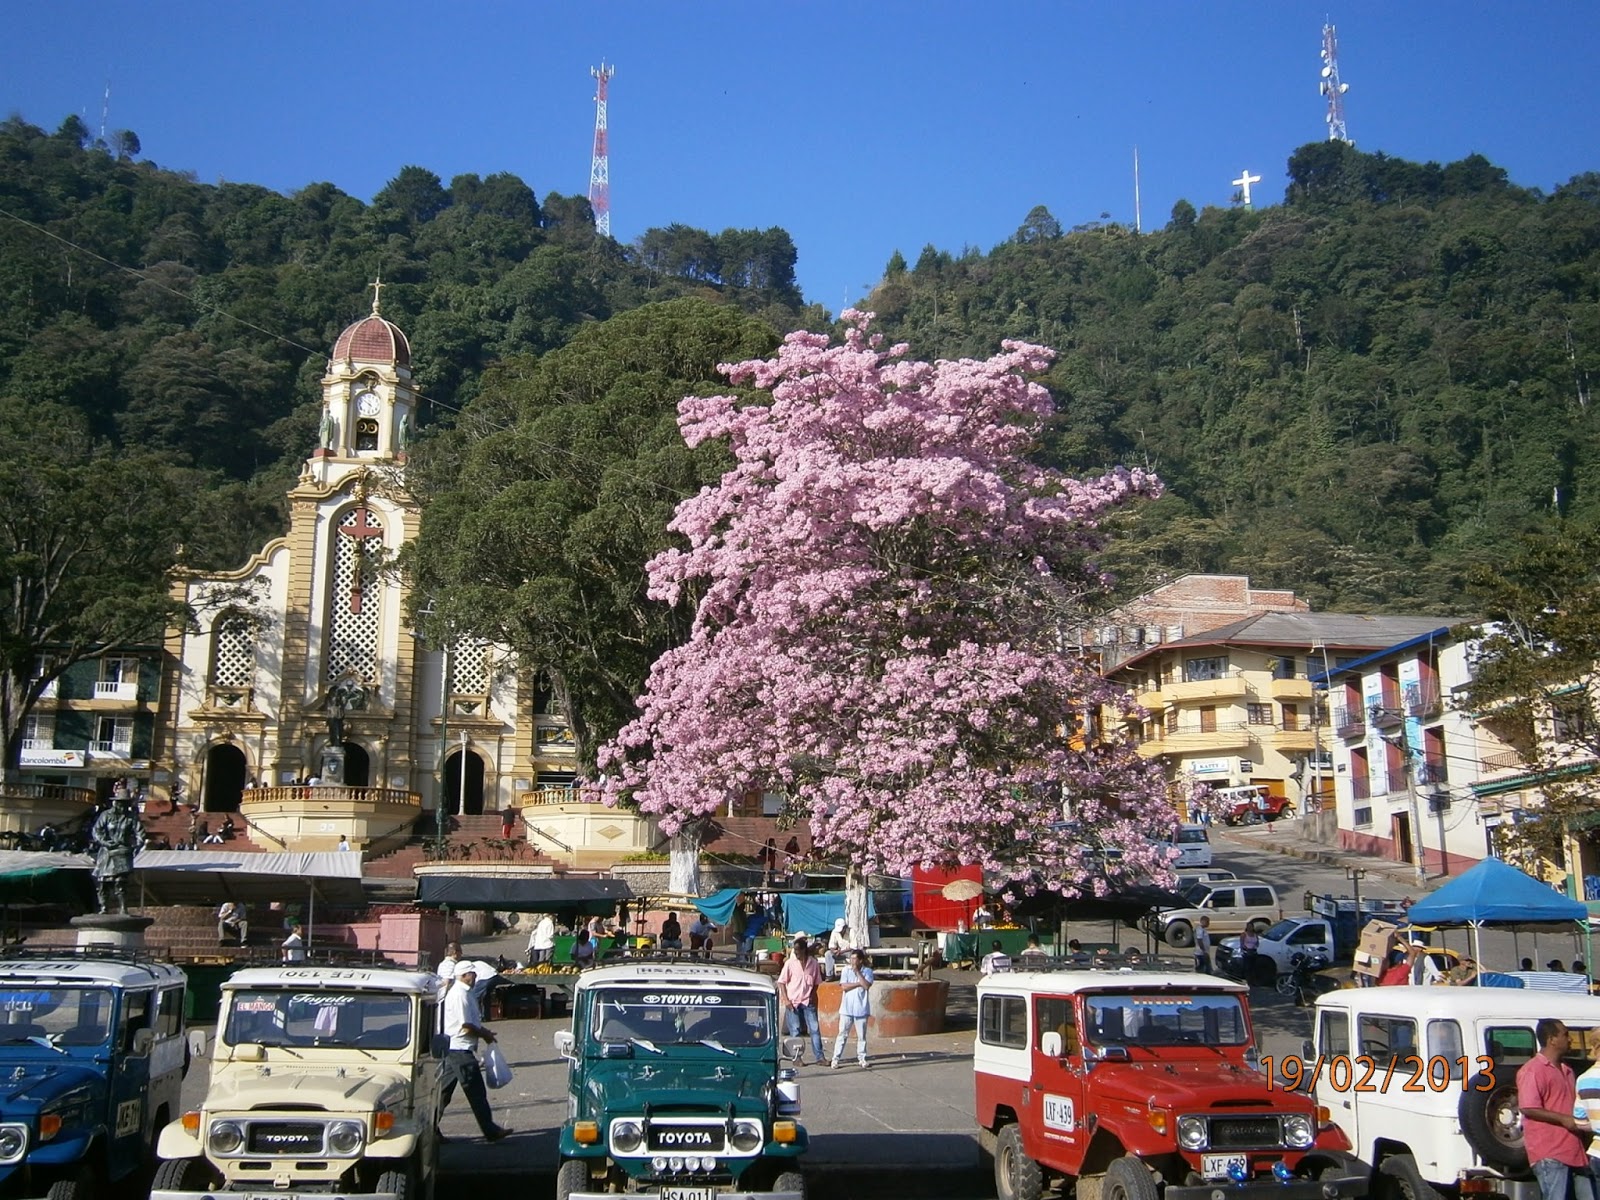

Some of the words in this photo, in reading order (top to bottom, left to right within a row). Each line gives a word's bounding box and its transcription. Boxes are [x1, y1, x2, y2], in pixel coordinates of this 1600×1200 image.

[289, 993, 356, 1007] Toyota
[660, 995, 703, 1004] TOYOTA
[249, 1001, 276, 1011] MANGO
[657, 1132, 712, 1144] TOYOTA
